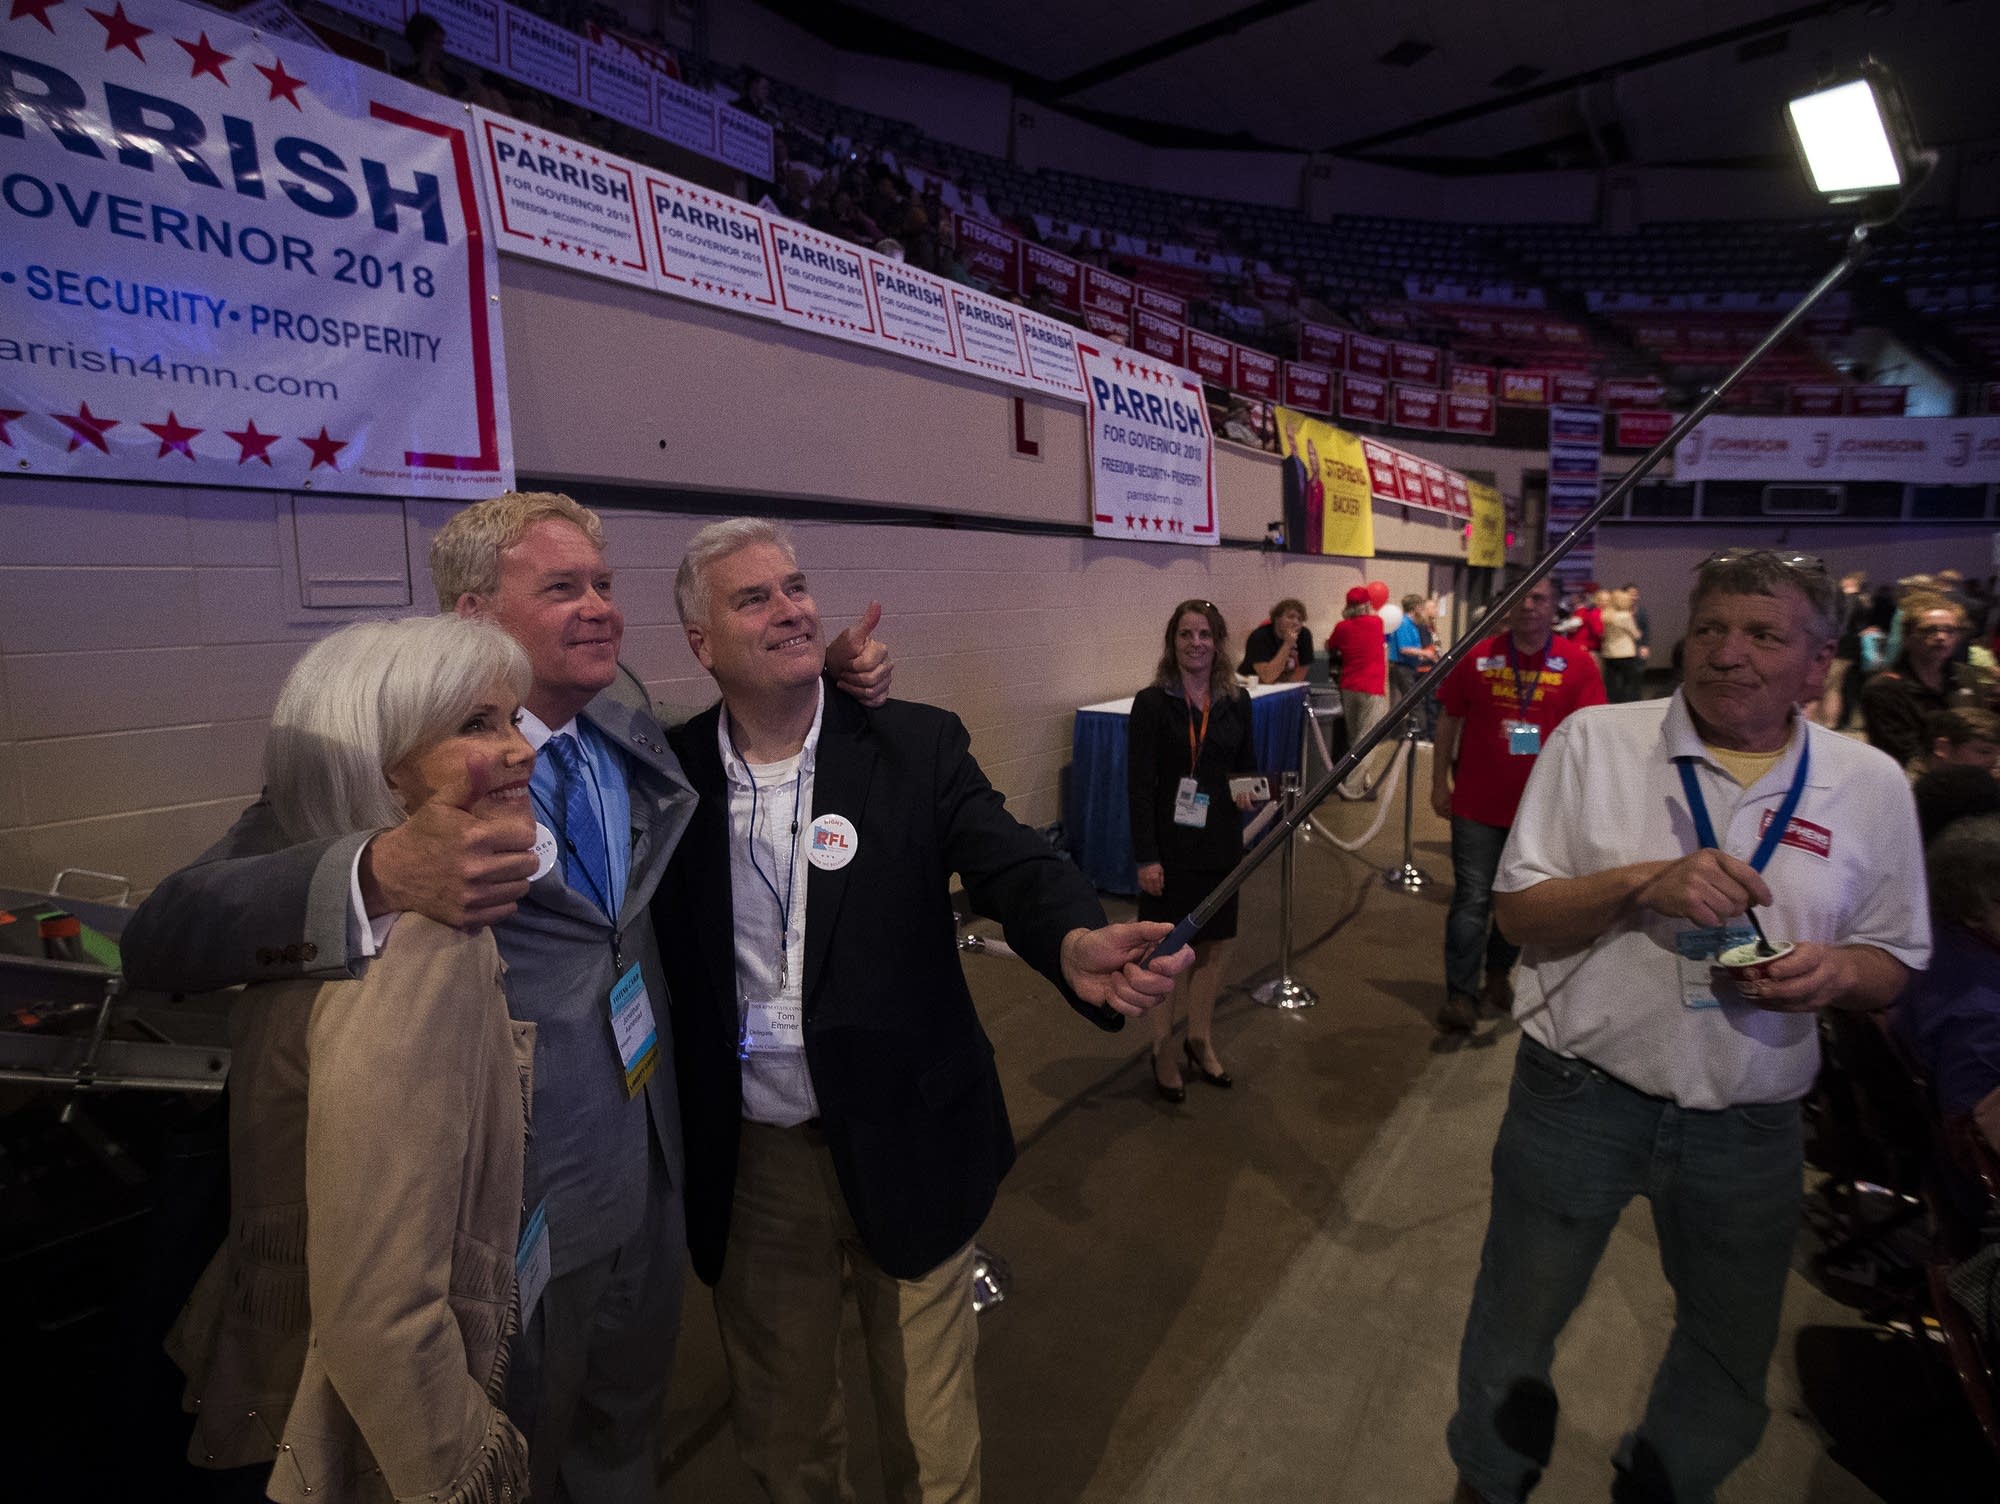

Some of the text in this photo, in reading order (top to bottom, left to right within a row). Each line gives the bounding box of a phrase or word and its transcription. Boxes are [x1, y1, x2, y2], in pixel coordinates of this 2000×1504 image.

[496, 139, 630, 204] PARRISH
[505, 174, 631, 224] FOR GOVERNOR 2018
[2, 173, 436, 299] OVERNOR 2018
[655, 194, 760, 246] PARRISH
[662, 225, 684, 240] FOR
[686, 232, 740, 256] GOVERNOR
[777, 238, 861, 280] PARRISH
[875, 271, 944, 308] PARRISH
[27, 264, 442, 363] SECURITY PROSPERITY
[957, 301, 1015, 333] PARRISH
[1024, 323, 1075, 352] PARRISH
[1092, 375, 1205, 438] PARRISH
[1015, 397, 1038, 456] L
[1104, 424, 1126, 444] FOR
[1128, 429, 1182, 456] GOVERNOR
[816, 831, 849, 849] RFL
[771, 1021, 800, 1030] Emmer
[777, 1012, 795, 1021] Tom
